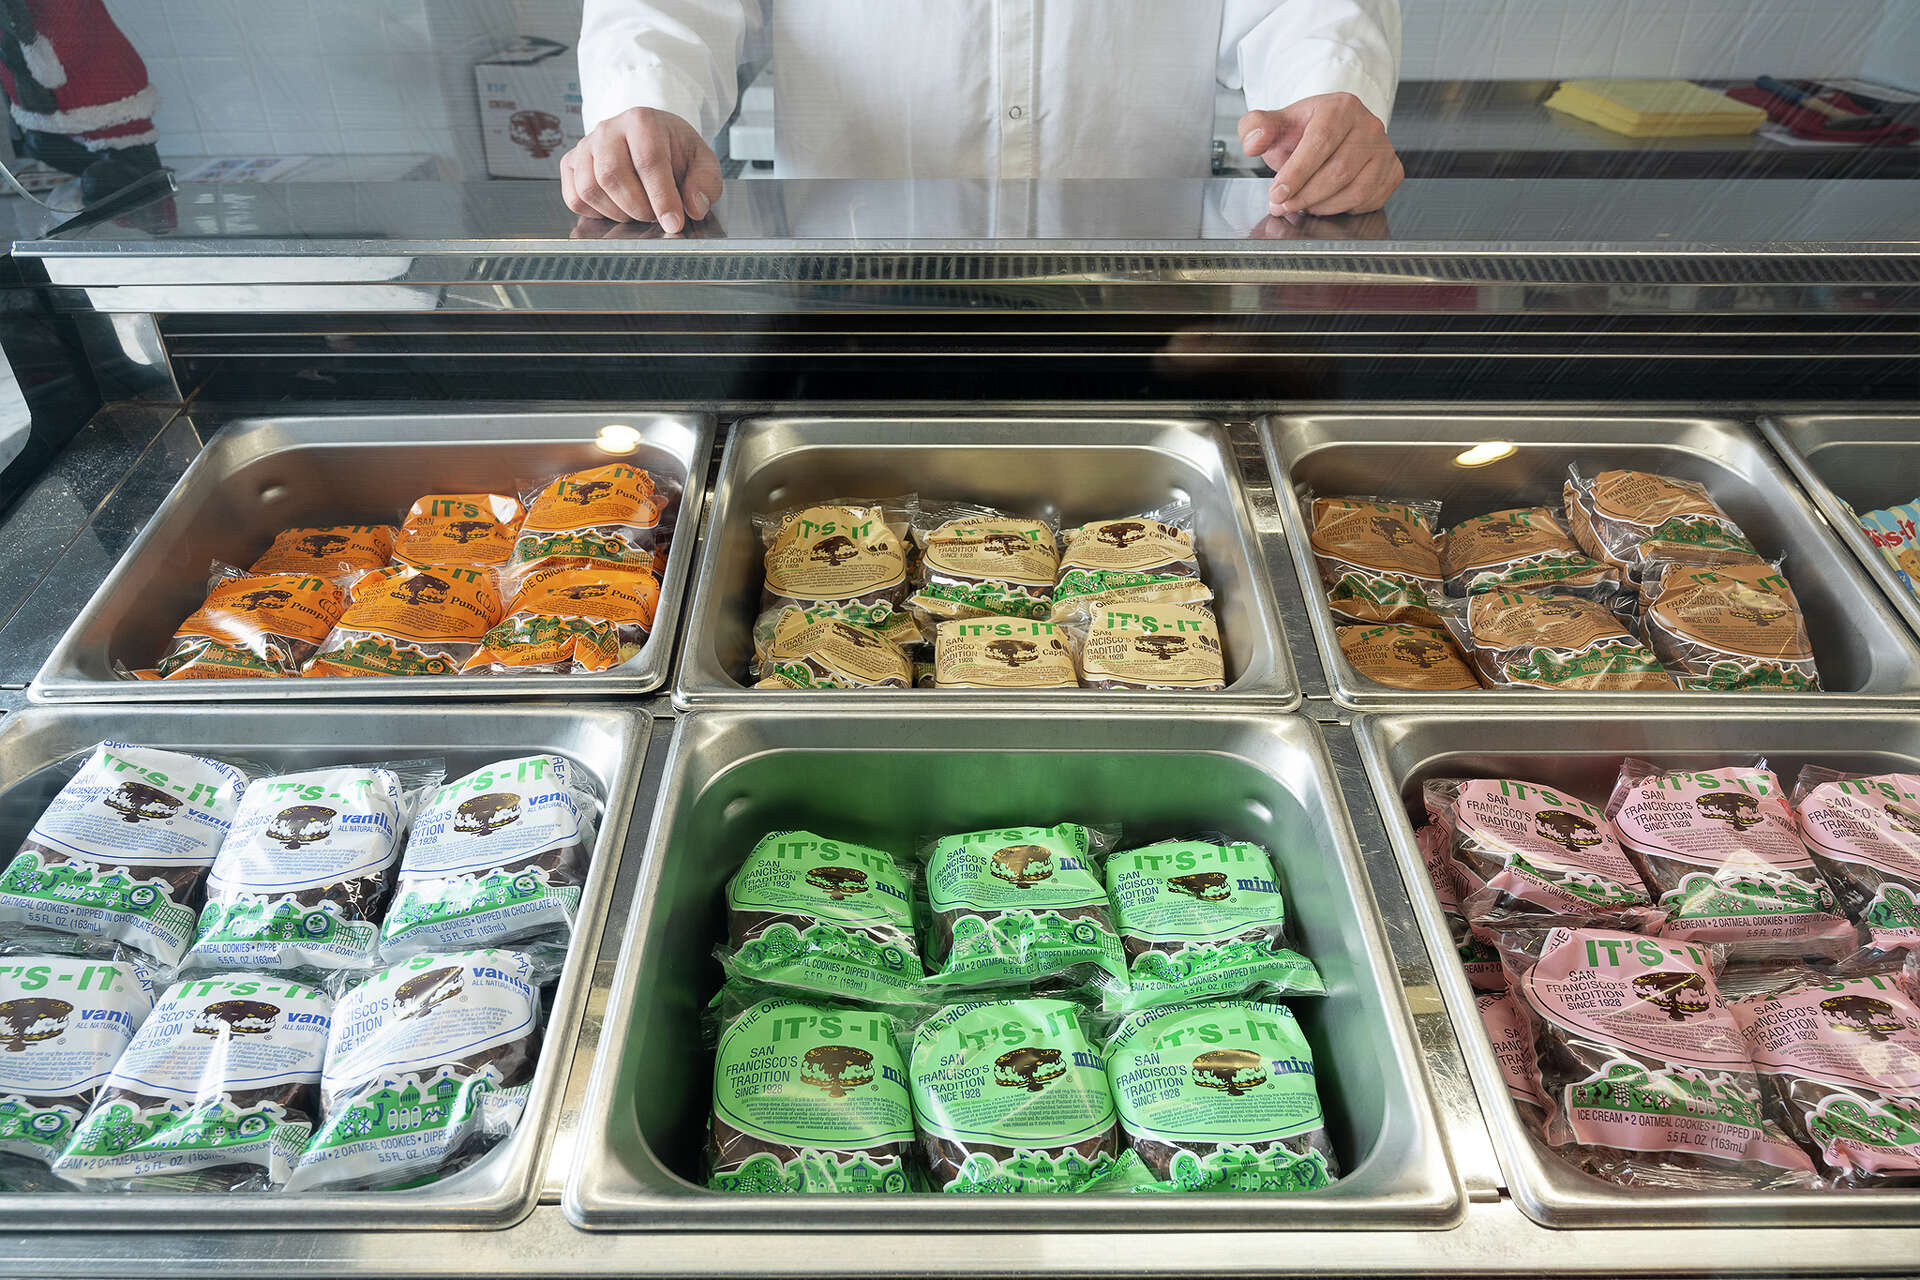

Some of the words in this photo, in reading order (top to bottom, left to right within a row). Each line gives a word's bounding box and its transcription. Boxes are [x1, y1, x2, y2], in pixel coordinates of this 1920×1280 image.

[796, 520, 873, 539] IT'S-IT
[938, 545, 979, 554] TRADITION
[519, 579, 536, 596] THE
[959, 623, 1058, 636] IT'S-IT
[1107, 612, 1203, 633] IT'S-IT
[945, 636, 964, 646] SAN
[1092, 629, 1112, 637] SAN
[958, 656, 974, 664] 1928
[103, 753, 220, 809] IT'S-IT
[434, 757, 555, 805] IT'S-IT
[1655, 770, 1770, 796] IT'S-IT
[528, 792, 578, 815] vanilla
[1486, 793, 1509, 806] SAN
[1641, 790, 1666, 800] SAN
[1824, 797, 1852, 810] SAN
[1466, 800, 1532, 822] FRANCISCO'S
[1624, 801, 1694, 819] FRANCISCO'S
[1633, 811, 1694, 826] TRADITION
[1807, 807, 1882, 824] FRANCISCO'S
[341, 813, 393, 838] vanilla
[1474, 812, 1528, 833] TRADITION
[1643, 822, 1669, 832] SINCE
[1670, 820, 1691, 828] 1928
[1820, 818, 1880, 834] TRADITION
[419, 836, 438, 846] 1928
[1832, 830, 1858, 840] SINCE
[1858, 831, 1879, 841] 1928
[777, 842, 890, 873] IT'S-IT
[946, 846, 966, 861] SAN
[1133, 845, 1249, 871] IT'S-IT
[757, 860, 780, 868] SAN
[934, 855, 988, 881] FRANCISCO'S
[743, 874, 796, 888] TRADITION
[937, 864, 983, 888] TRADITION
[960, 872, 978, 880] 1928
[1118, 871, 1140, 881] SAN
[1137, 896, 1155, 906] 1928
[0, 895, 34, 910] OATMEAL
[36, 899, 69, 915] COOKIES
[76, 907, 104, 919] DIPPED
[105, 912, 112, 921] IN
[113, 914, 152, 934] CHOCOLATE
[151, 925, 179, 948] COATING
[28, 912, 41, 922] 5.5
[42, 915, 53, 924] FL.
[55, 917, 68, 927] OZ.
[70, 919, 102, 932] (163mL)
[441, 918, 471, 933] COOKIES
[476, 912, 502, 924] DIPPED
[502, 910, 511, 919] IN
[512, 900, 551, 918] CHOCOLATE
[1681, 918, 1707, 930] CREAM
[1712, 918, 1718, 928] 2
[1719, 917, 1752, 928] OATMEAL
[1752, 916, 1783, 926] COOKIES
[439, 934, 451, 943] 5.5
[464, 929, 476, 938] OZ.
[477, 922, 507, 937] (163mL)
[222, 944, 250, 953] COOKIES
[252, 954, 282, 965] (163mL)
[0, 966, 122, 991] T'S-IT
[812, 959, 840, 972] COOKIES
[845, 965, 869, 979] DIPPED
[876, 972, 908, 990] CHOCOLATE
[1188, 973, 1218, 987] COOKIES
[1223, 966, 1249, 980] DIPPED
[1258, 961, 1295, 974] CHOCOLATE
[1569, 970, 1596, 982] SAN
[471, 979, 483, 987] ALL
[484, 980, 512, 991] NATURAL
[1546, 981, 1628, 992] FRANCISCO'S
[1557, 990, 1625, 1003] TRADITION
[1567, 1000, 1596, 1011] SINCE
[1597, 999, 1622, 1008] 1928
[1753, 1001, 1783, 1016] SAN
[88, 1022, 121, 1033] NATURAL
[281, 1023, 294, 1032] ALL
[736, 1012, 760, 1034] THE
[919, 1019, 944, 1042] THE
[959, 1009, 1078, 1052] IT'S-IT
[1113, 1025, 1137, 1048] THE
[1136, 1003, 1193, 1027] ORIGINAL
[1740, 1005, 1818, 1041] FRANCISCO'S
[1751, 1018, 1819, 1045] TRADITION
[1153, 1020, 1278, 1050] IT'S-IT
[1764, 1035, 1793, 1053] SINCE
[1794, 1031, 1819, 1041] 1928
[750, 1045, 775, 1058] SAN
[940, 1053, 965, 1066] SAN
[1134, 1052, 1160, 1067] SAN
[726, 1055, 798, 1077] FRANCISCO'S
[730, 1070, 790, 1089] TRADITION
[918, 1064, 990, 1087] FRANCISCO'S
[1115, 1065, 1188, 1090] FRANCISCO'S
[735, 1085, 759, 1098] SINCE
[762, 1084, 783, 1095] 1928
[926, 1076, 985, 1096] TRADITION
[960, 1088, 981, 1099] 1928
[1124, 1077, 1184, 1100] TRADITION
[1132, 1094, 1158, 1109] SINCE
[1160, 1088, 1181, 1102] 1928
[1577, 1109, 1592, 1121] ICE
[1593, 1109, 1623, 1124] CREAM
[1630, 1114, 1637, 1126] 2
[1638, 1116, 1672, 1128] OATMEAL
[1674, 1119, 1711, 1132] COOKIES
[1716, 1124, 1750, 1140] DIPPED
[1751, 1129, 1762, 1141] IN
[334, 1149, 340, 1159] 2
[340, 1143, 377, 1157] OATMEAL
[380, 1135, 417, 1150] COOKIES
[423, 1128, 453, 1144] DIPPED
[1666, 1131, 1681, 1142] 5.5
[1681, 1133, 1693, 1144] FL.
[1695, 1135, 1708, 1146] OZ.
[1710, 1138, 1747, 1154] (163mL)
[96, 1153, 141, 1169] OATMEAL
[378, 1153, 392, 1162] 5.5
[407, 1148, 420, 1159] OZ.
[134, 1162, 152, 1175] 5.5
[169, 1156, 185, 1167] OZ.
